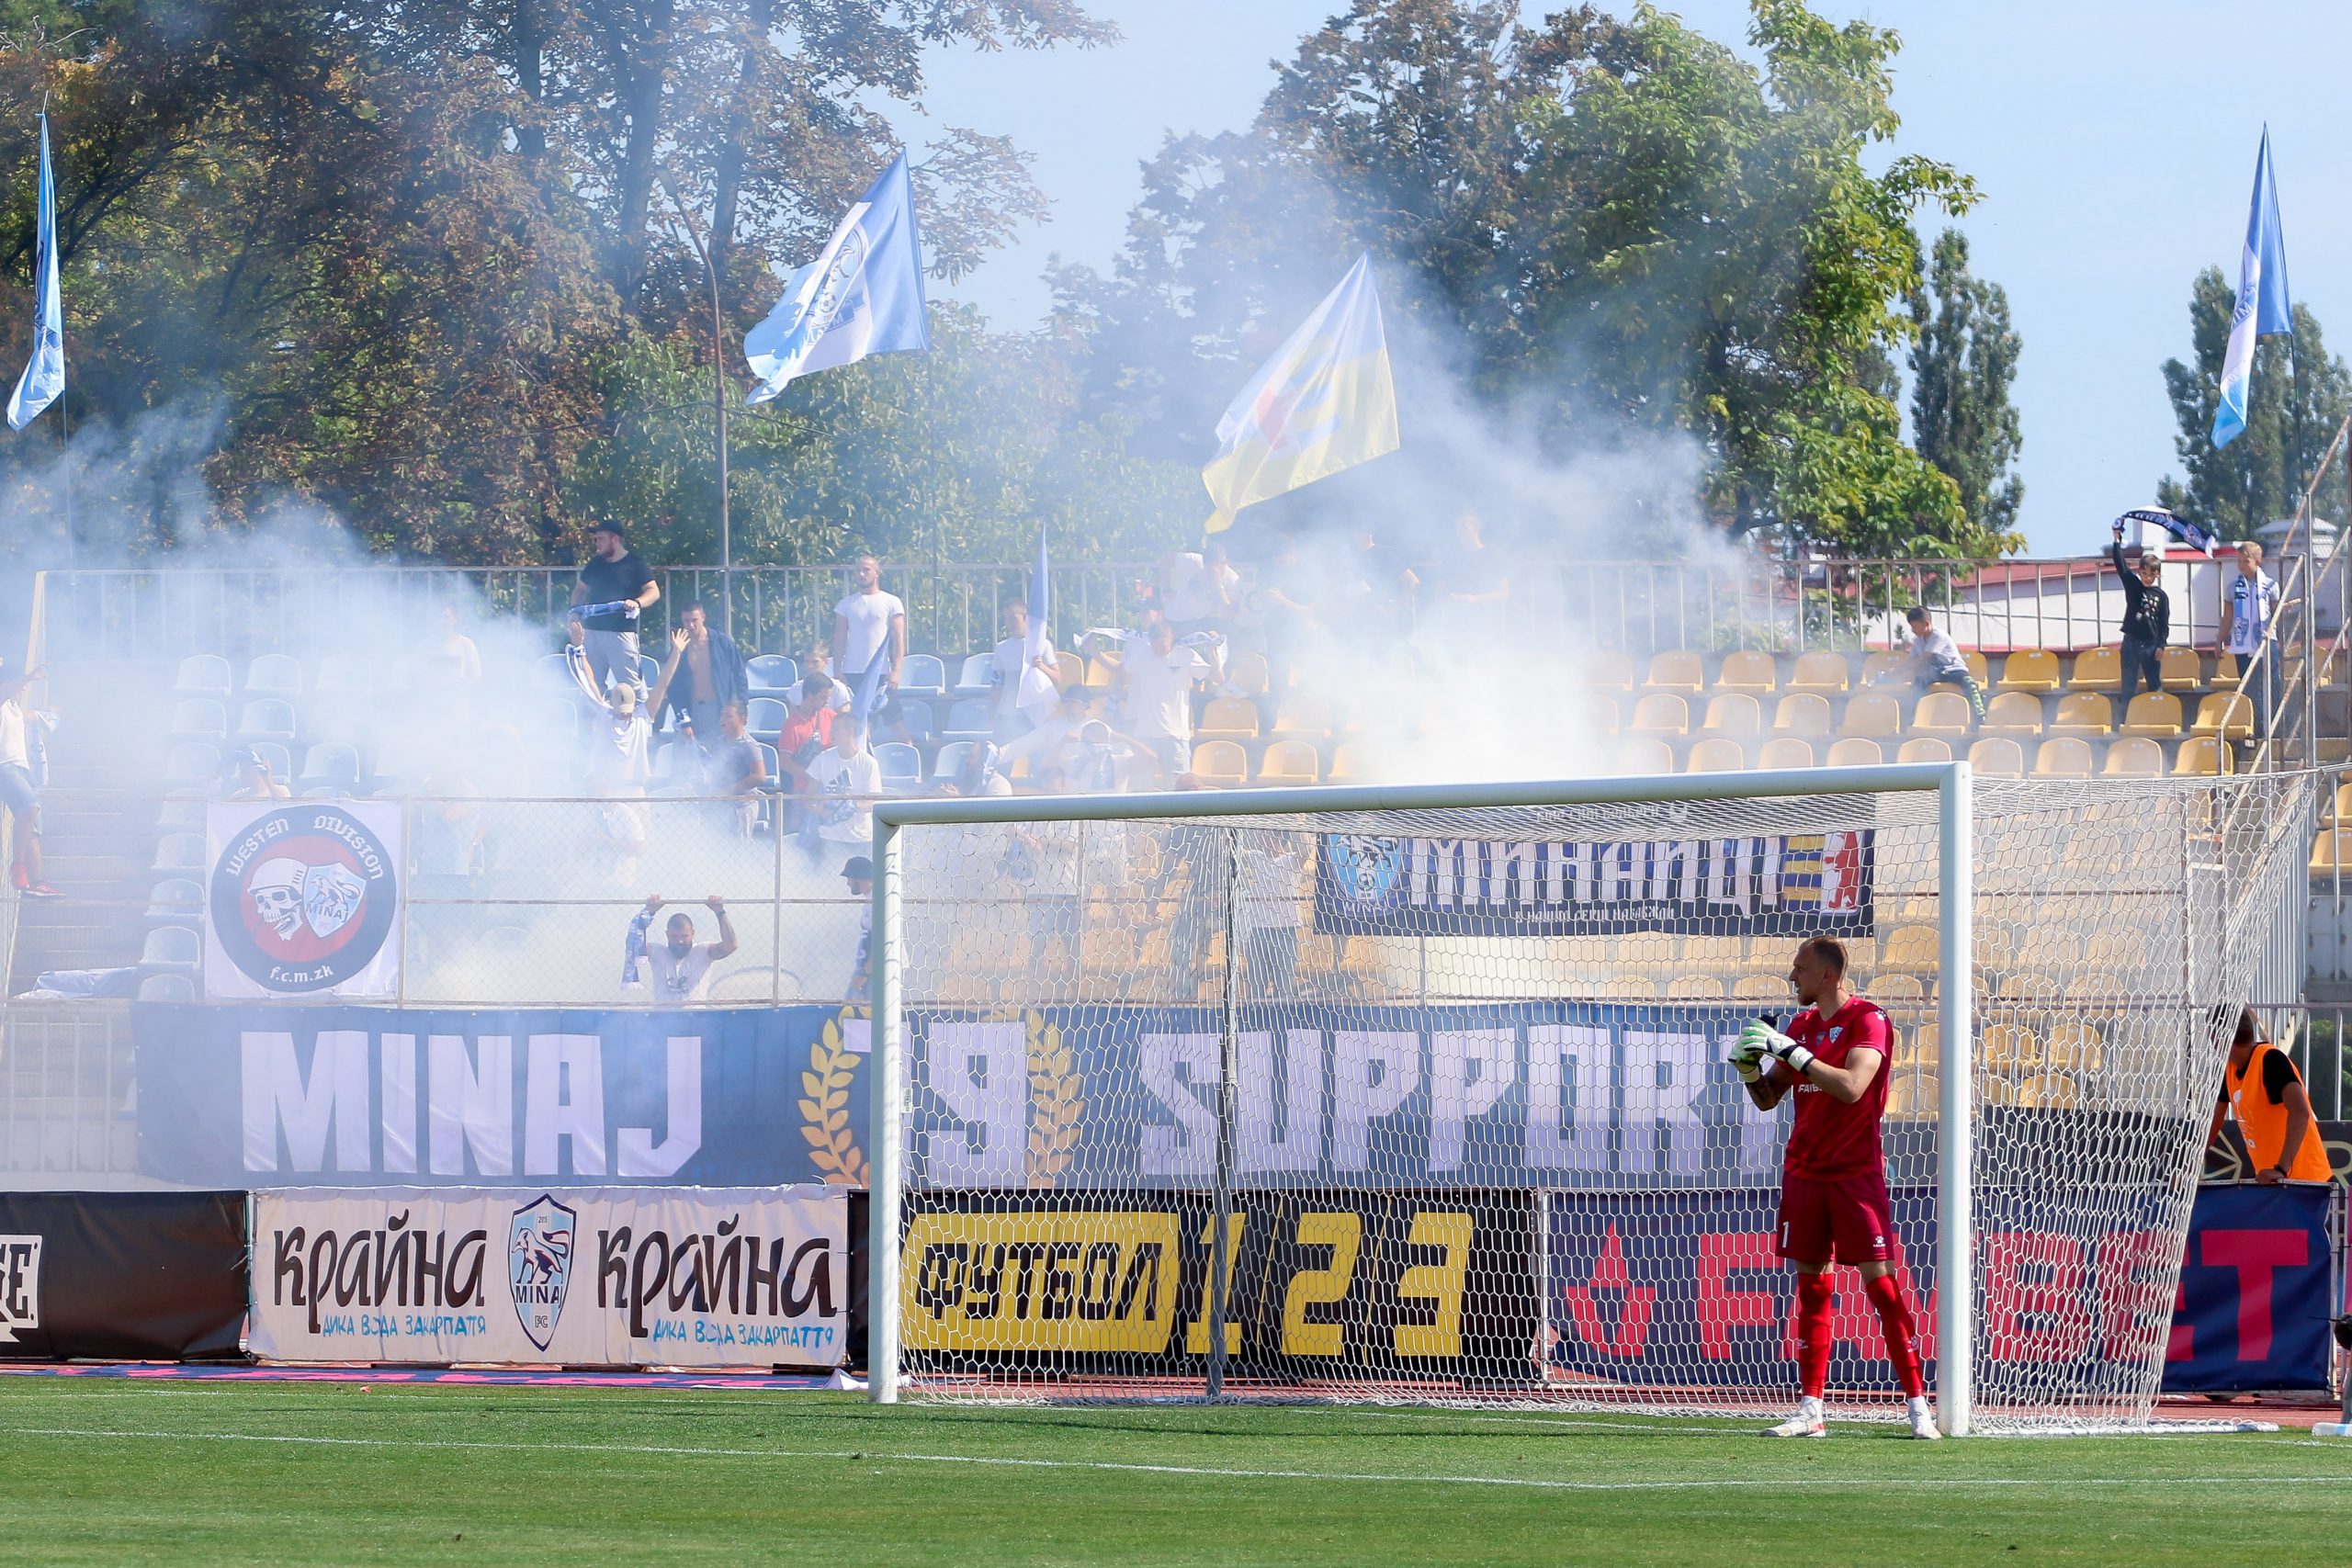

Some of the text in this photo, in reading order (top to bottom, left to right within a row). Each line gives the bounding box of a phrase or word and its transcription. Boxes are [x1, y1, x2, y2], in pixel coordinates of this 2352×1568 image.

[226, 815, 384, 880] WESTEN DIVISION
[305, 902, 349, 922] MINAJ
[241, 1029, 702, 1177] MINAJ
[1781, 1221, 1790, 1248] 1
[921, 1241, 1161, 1320] ФУТБОЛ
[322, 1314, 355, 1337] ДИКА
[534, 1314, 548, 1328] FC
[653, 1317, 686, 1342] ДИКА
